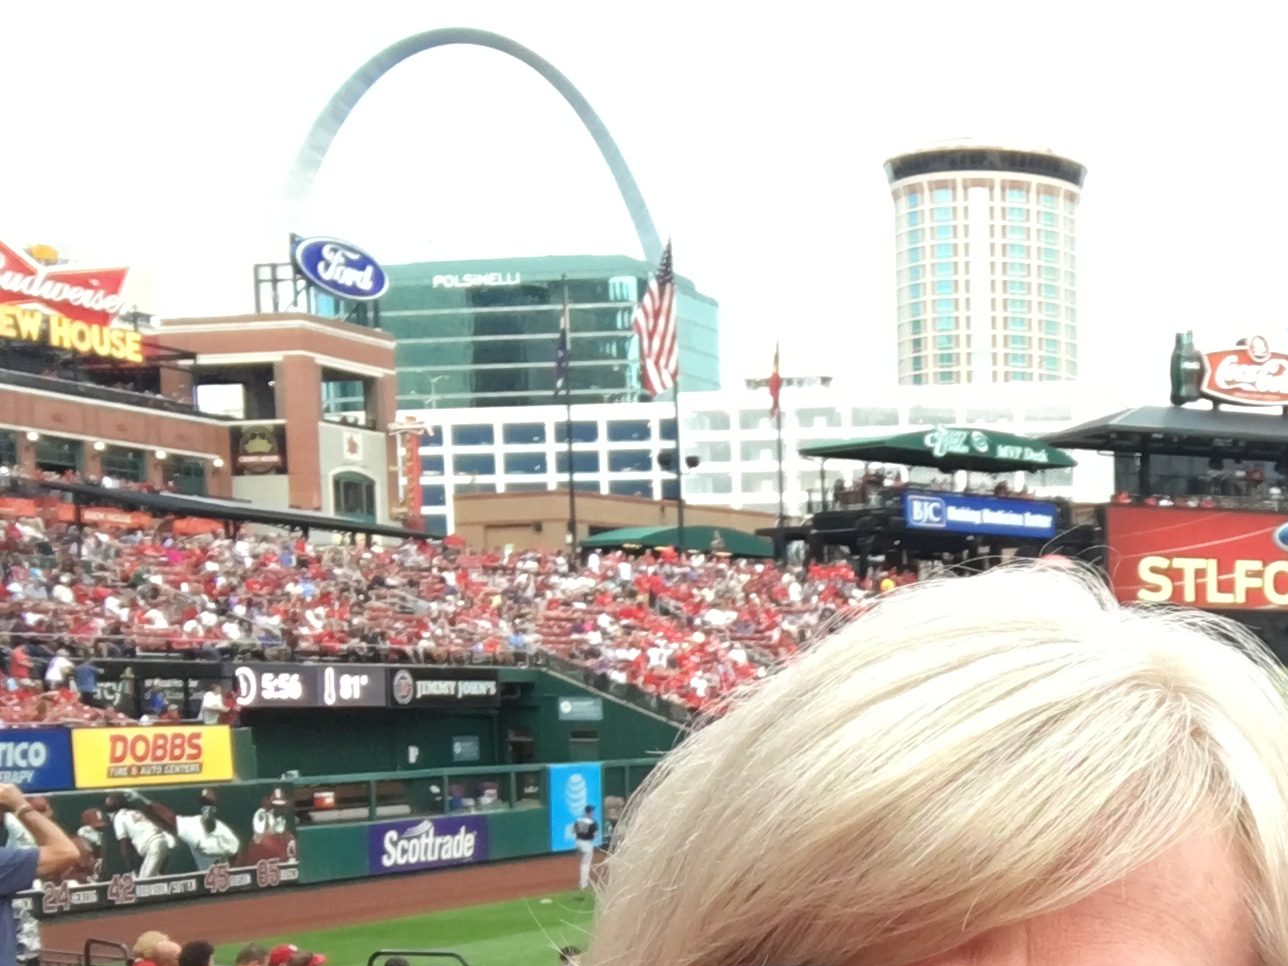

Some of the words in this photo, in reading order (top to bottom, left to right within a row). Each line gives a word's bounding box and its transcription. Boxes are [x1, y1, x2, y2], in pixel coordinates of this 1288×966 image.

[0, 251, 125, 315] udweiser
[317, 243, 374, 290] Ford
[50, 314, 143, 362] HOUSE
[912, 500, 942, 522] BJC
[109, 732, 203, 764] DOBBS
[381, 823, 476, 867] Scottrade
[204, 861, 230, 893] 45
[43, 880, 71, 913] 24
